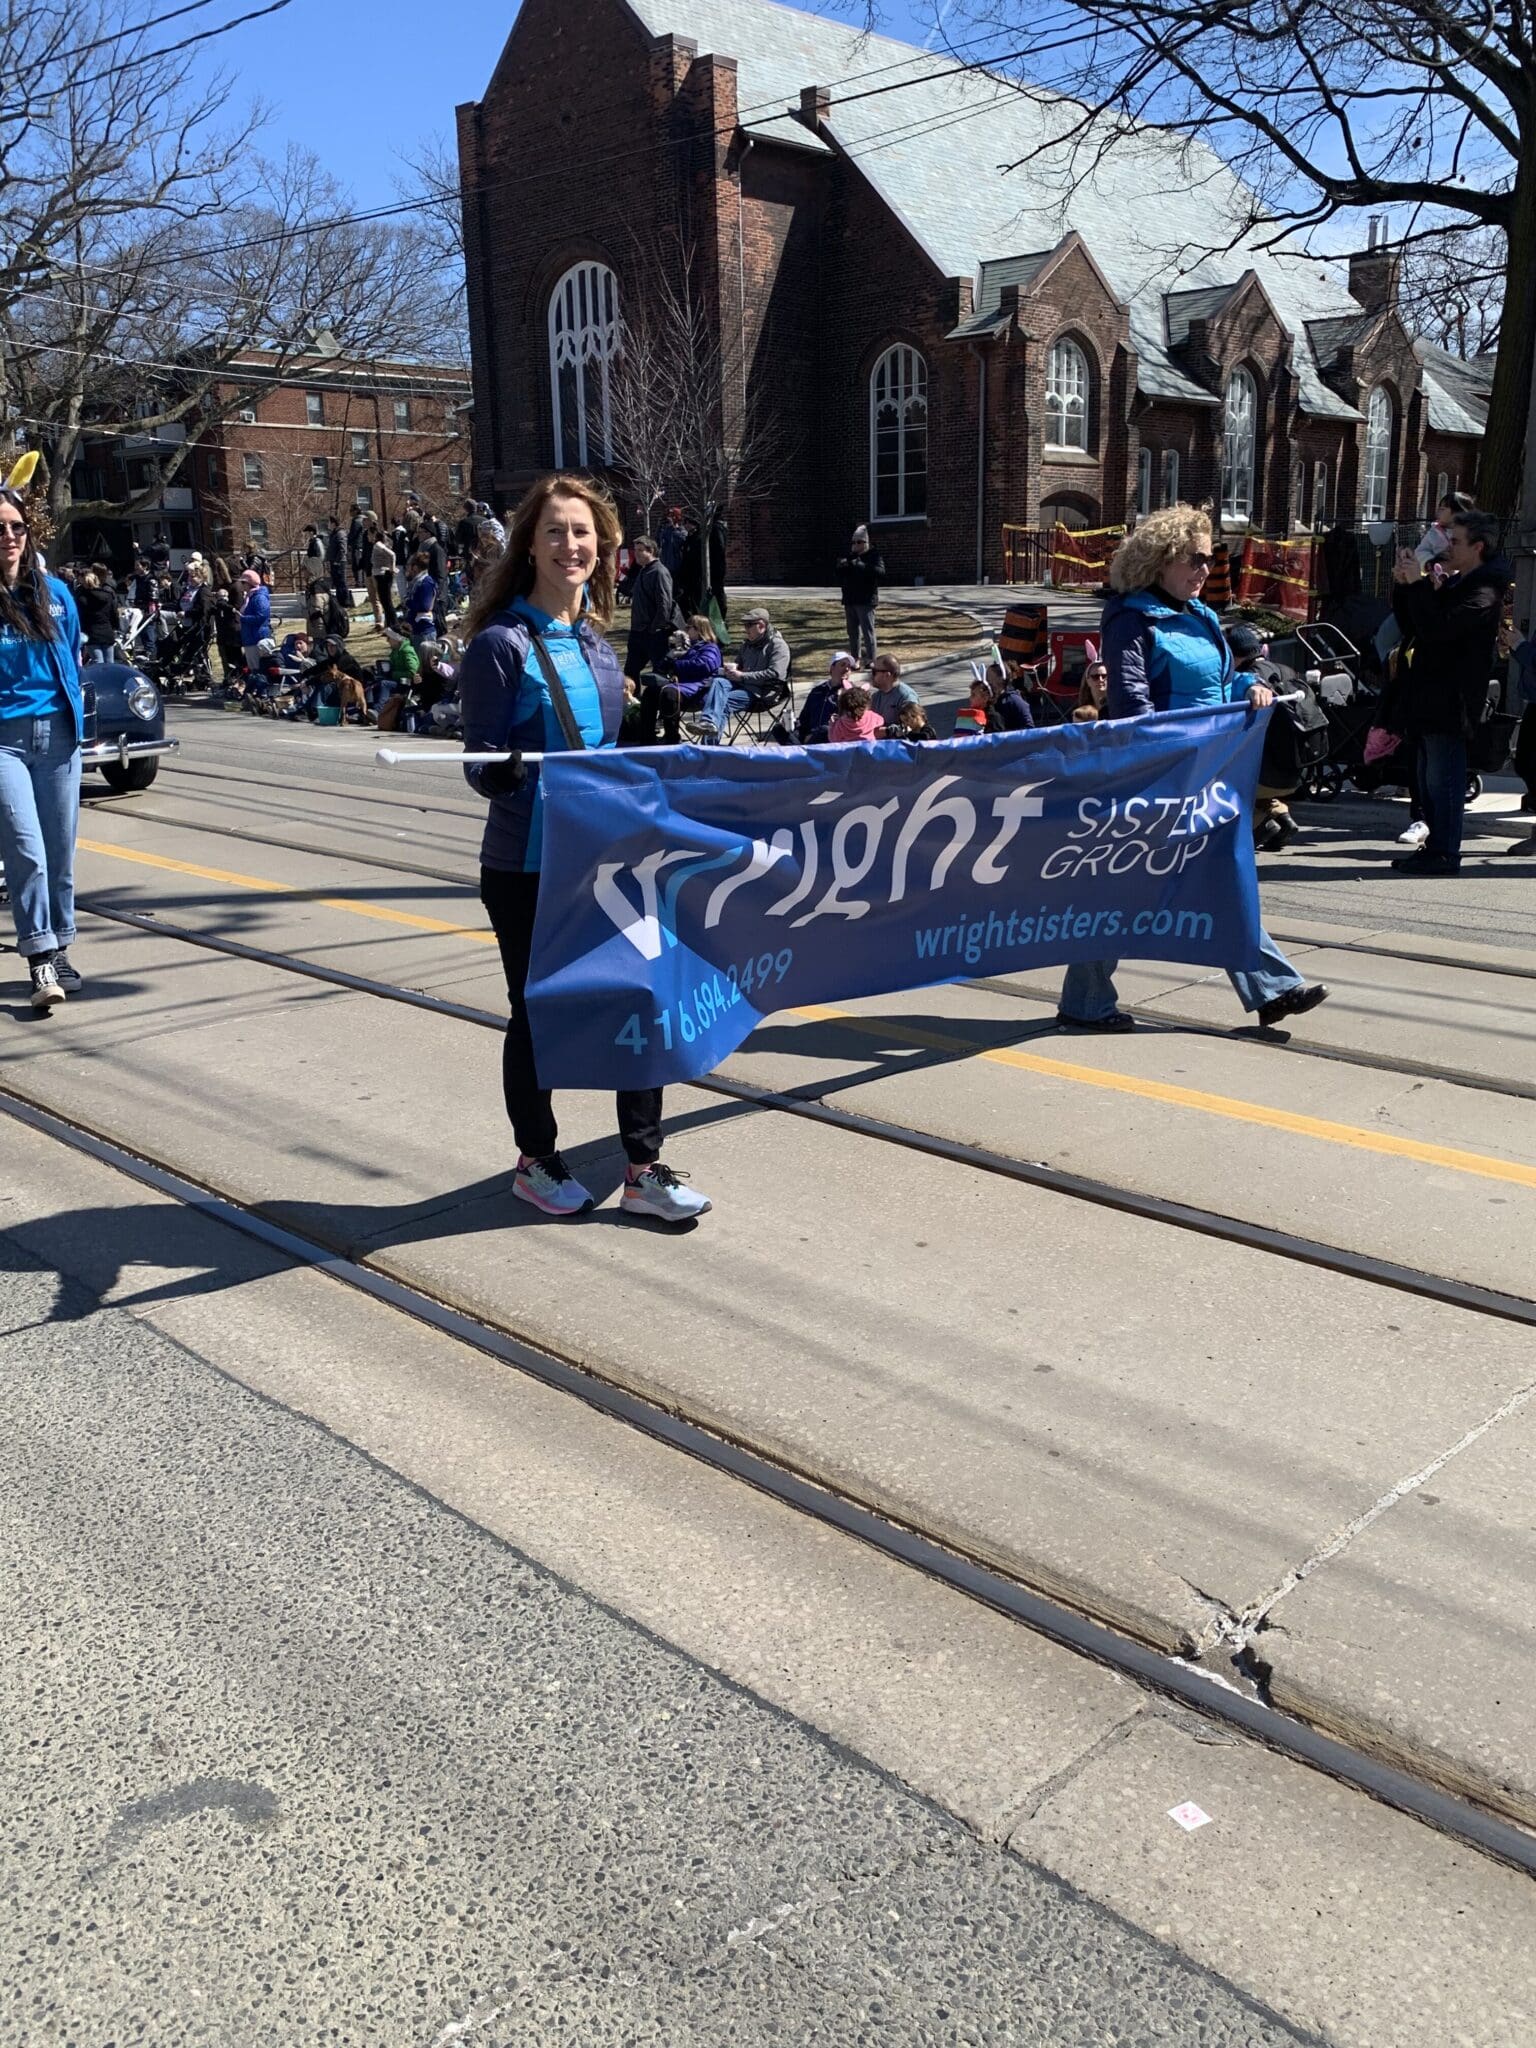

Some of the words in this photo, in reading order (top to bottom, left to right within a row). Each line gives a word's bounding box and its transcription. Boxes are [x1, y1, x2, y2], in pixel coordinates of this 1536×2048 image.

[1066, 781, 1241, 839] SISTERS
[1040, 835, 1209, 880] GROUP
[914, 903, 1214, 964] wrightsisters.com
[613, 948, 793, 1056] 416.694.2499
